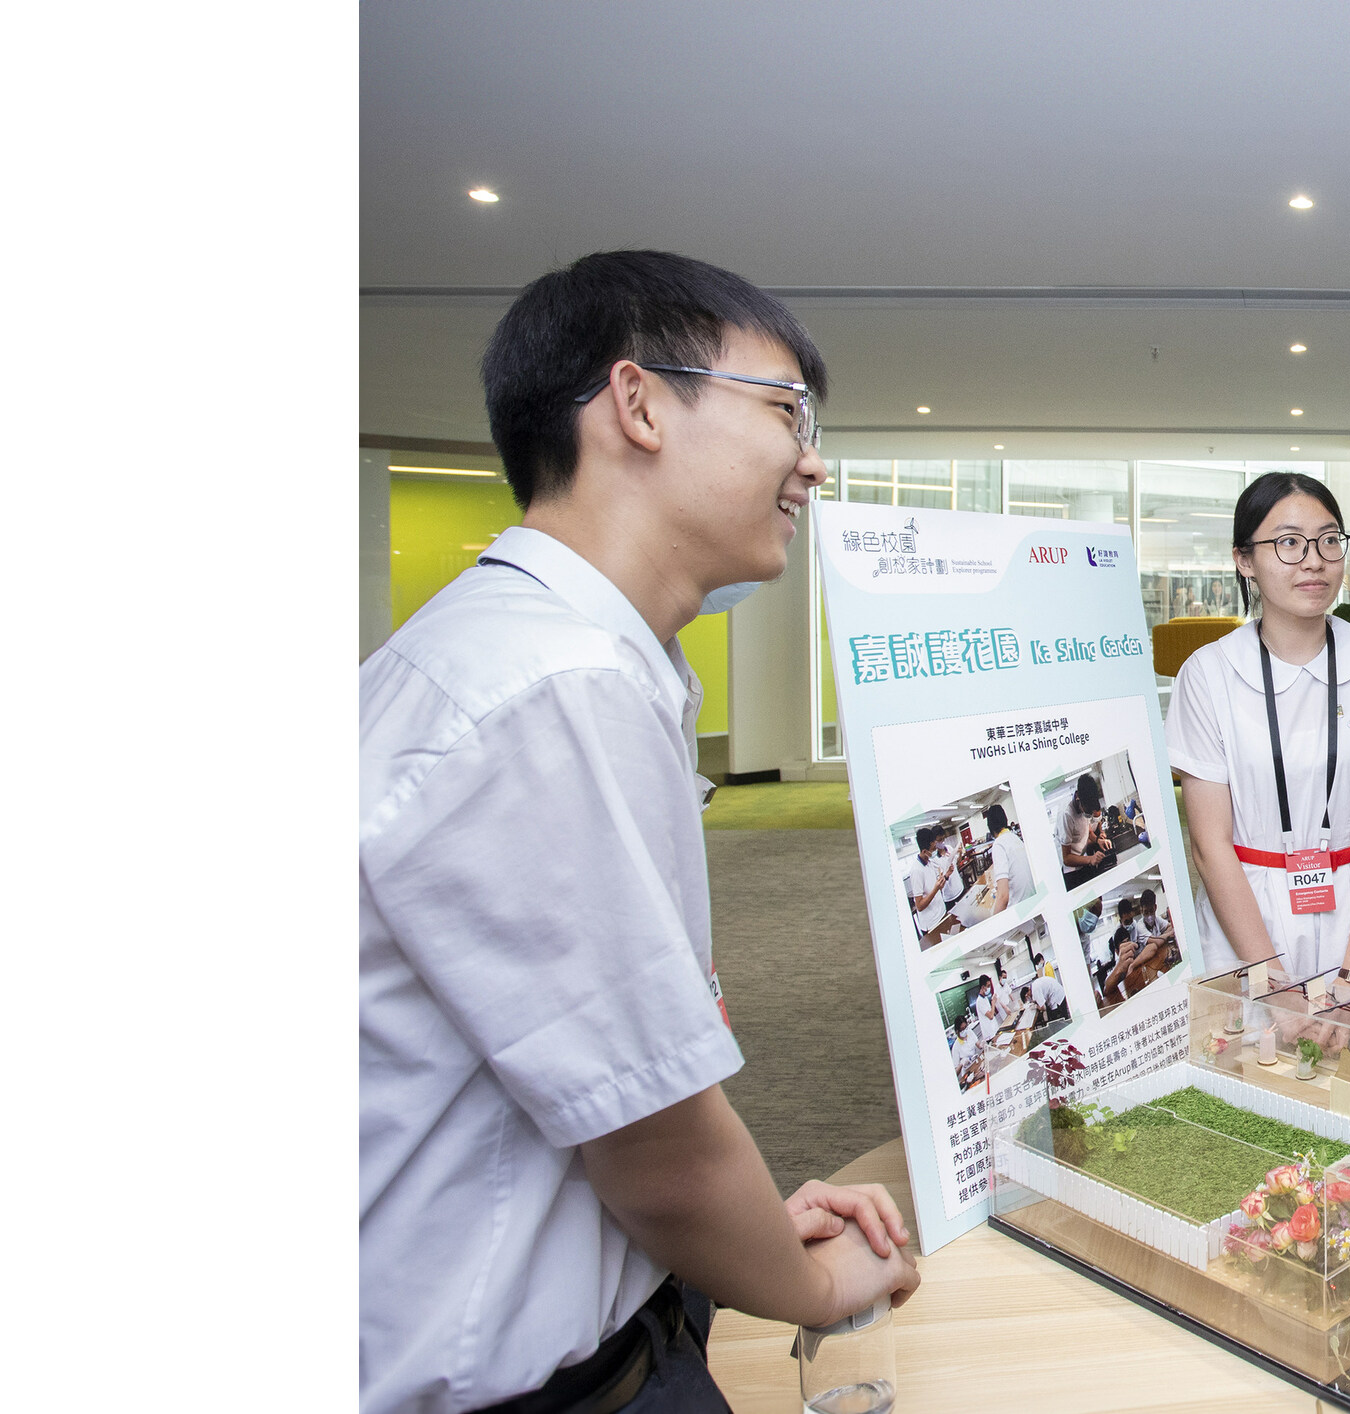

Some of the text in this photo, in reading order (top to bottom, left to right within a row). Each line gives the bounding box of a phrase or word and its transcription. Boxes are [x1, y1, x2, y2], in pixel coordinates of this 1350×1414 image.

[842, 530, 917, 554] 綠色校園
[877, 556, 949, 575] 創想家計劃
[951, 559, 977, 567] Sustainable
[1028, 546, 1069, 565] ARUP
[849, 627, 1021, 685] 嘉誠護花園
[1030, 634, 1144, 665] Ka Shing Garden
[985, 717, 1069, 742] 東華三院李嘉誠中學
[970, 731, 1090, 760] TWGHs Li Ka Shing College
[1296, 862, 1321, 870] Visitor
[1293, 873, 1326, 886] R047
